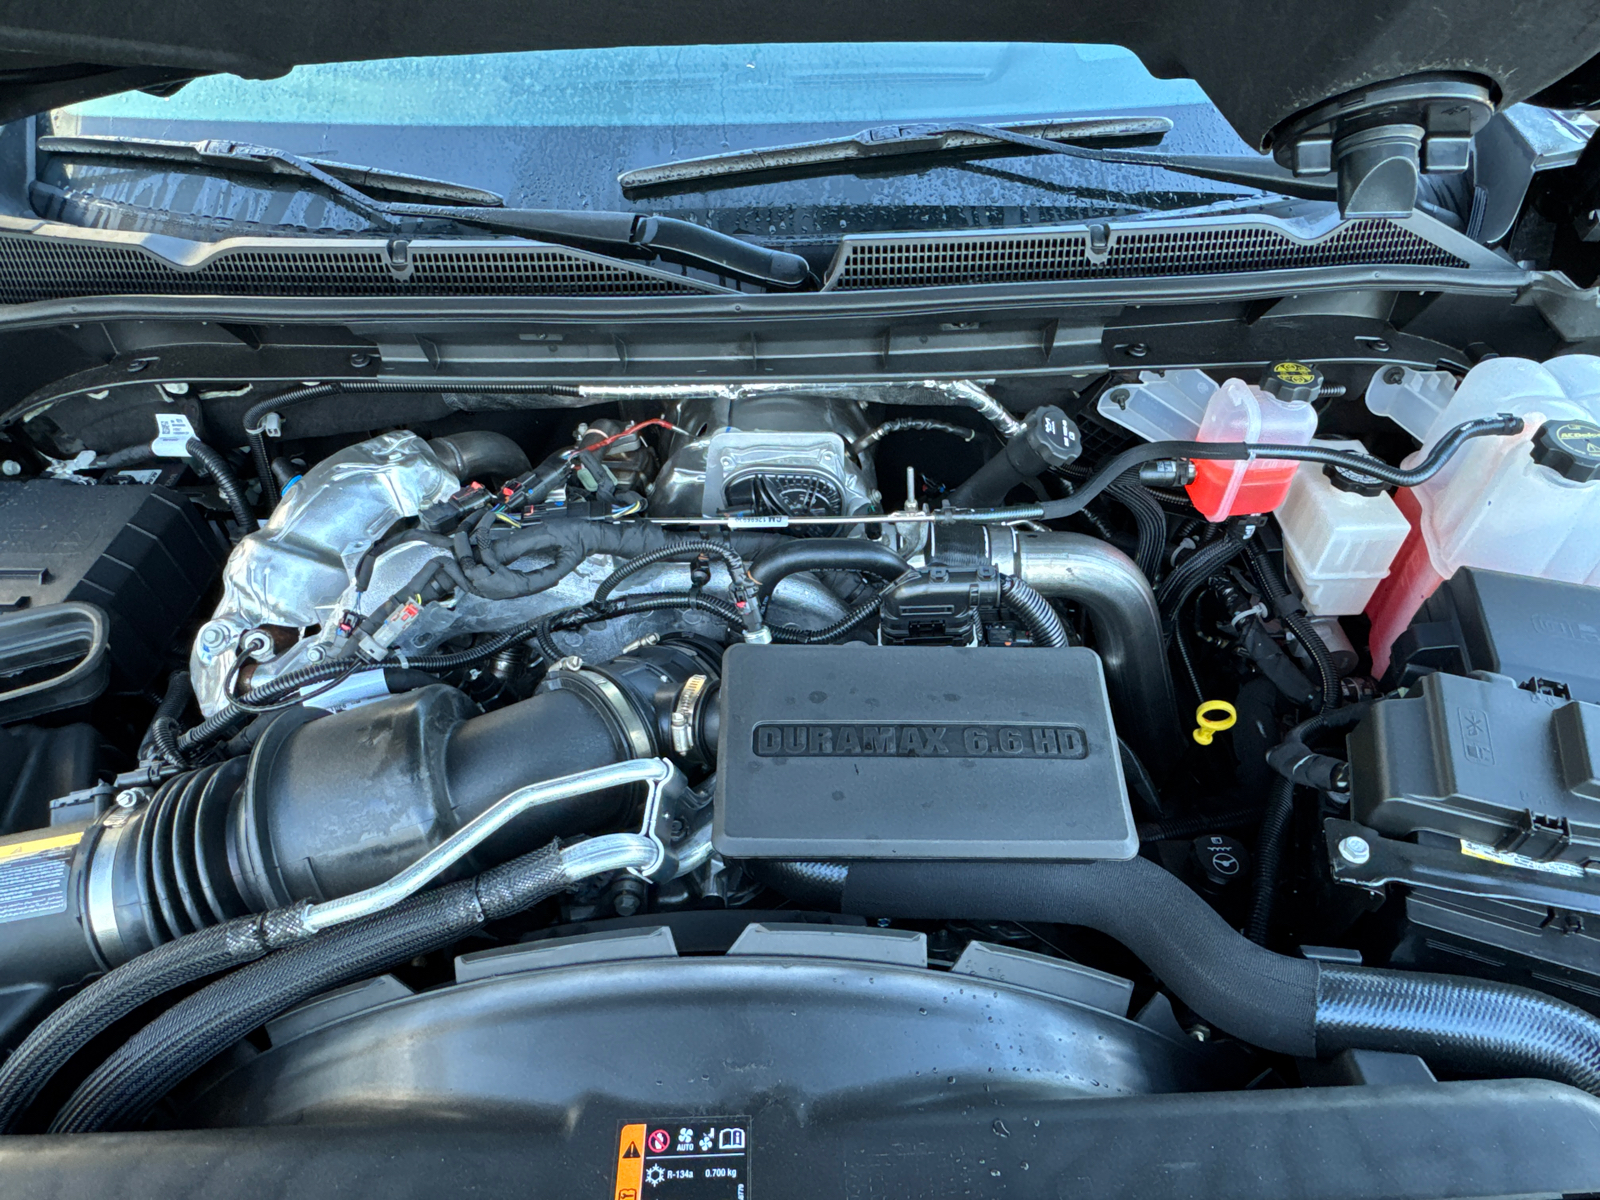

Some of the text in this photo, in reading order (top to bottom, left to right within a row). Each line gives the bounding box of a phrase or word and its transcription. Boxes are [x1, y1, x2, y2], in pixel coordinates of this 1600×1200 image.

[758, 726, 1085, 756] DURAMAX 6.6 HD
[676, 1143, 694, 1151] AUTO
[667, 1168, 737, 1179] R-134a 0.700 kg
